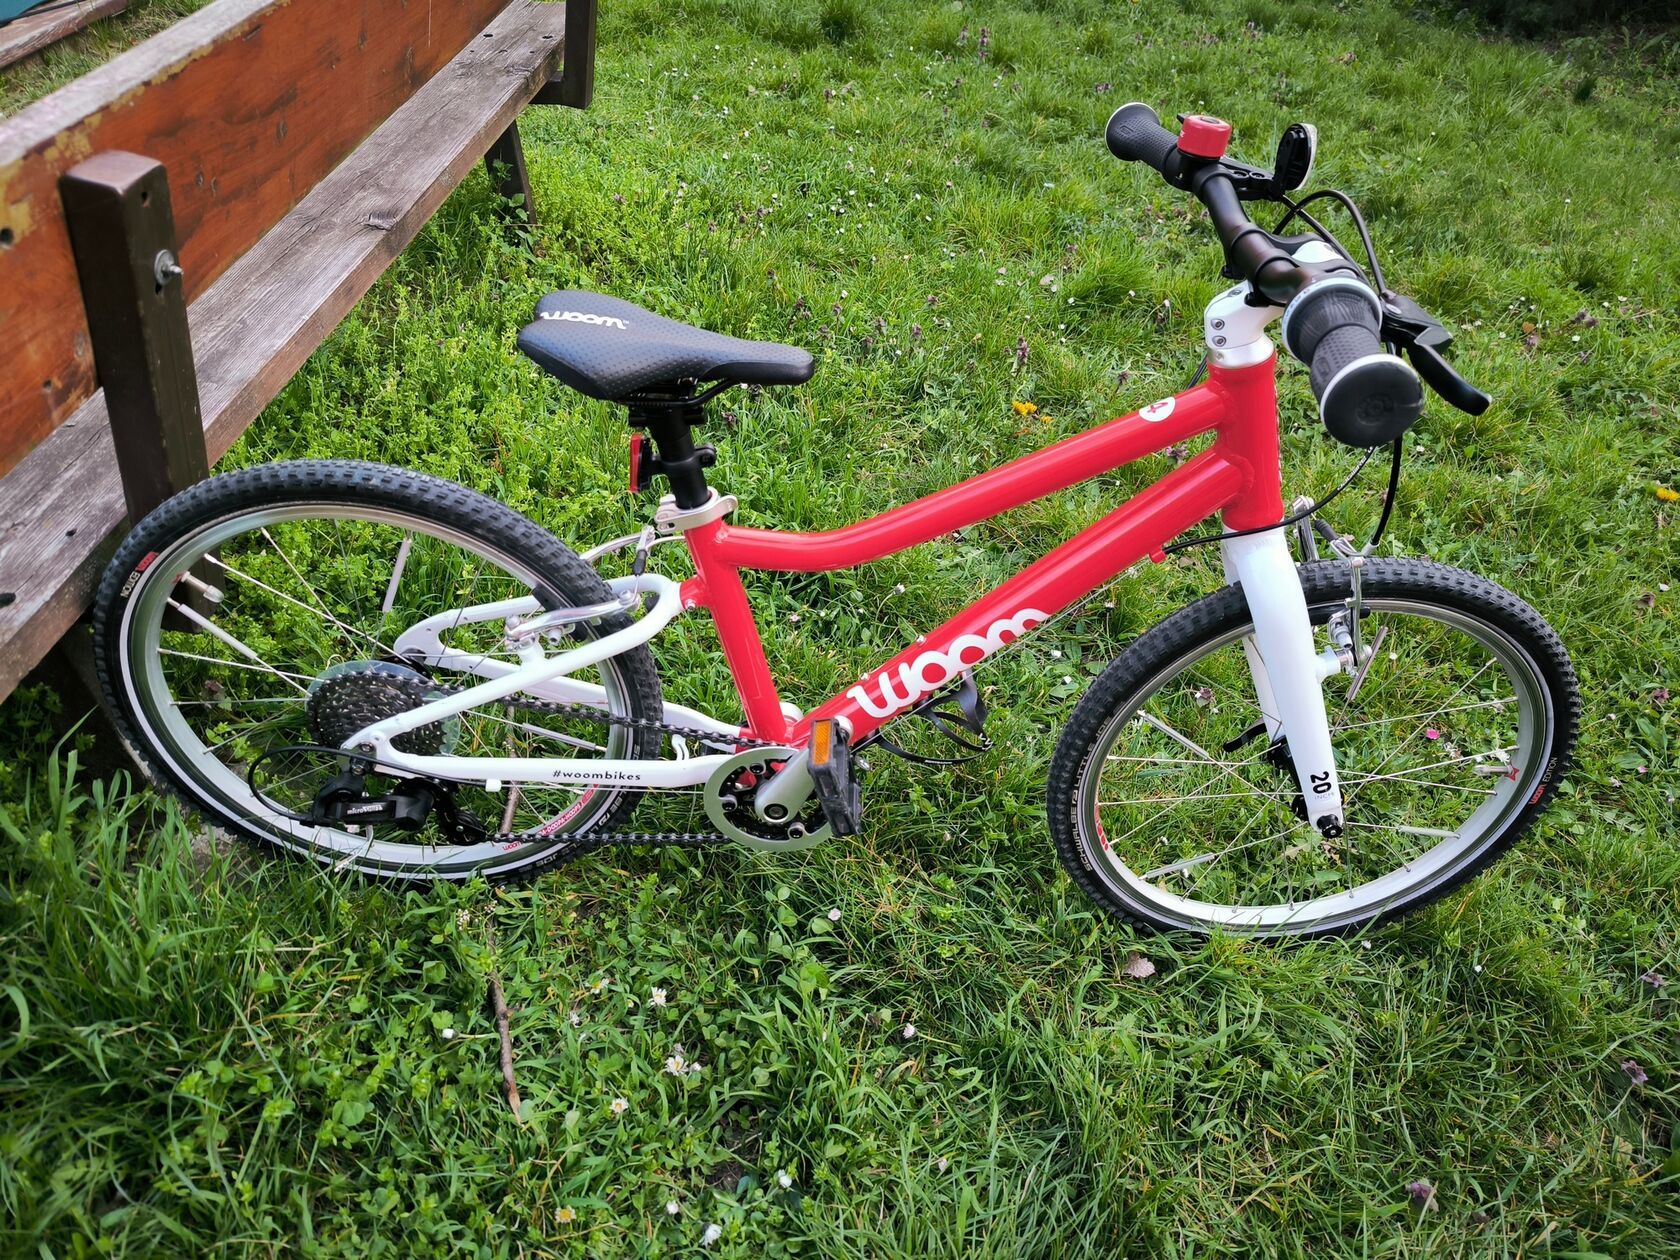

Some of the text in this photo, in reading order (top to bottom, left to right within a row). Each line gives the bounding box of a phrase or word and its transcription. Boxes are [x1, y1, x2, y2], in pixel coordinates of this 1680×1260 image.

[540, 311, 627, 330] woom
[1147, 402, 1168, 413] 4
[120, 571, 141, 598] EDITION
[846, 608, 1051, 718] woom
[553, 770, 641, 782] #woombikes
[1074, 743, 1096, 787] LITTLE
[1542, 757, 1558, 782] EDITION
[1310, 771, 1332, 794] 20
[1071, 806, 1093, 872] SCHWALBE
